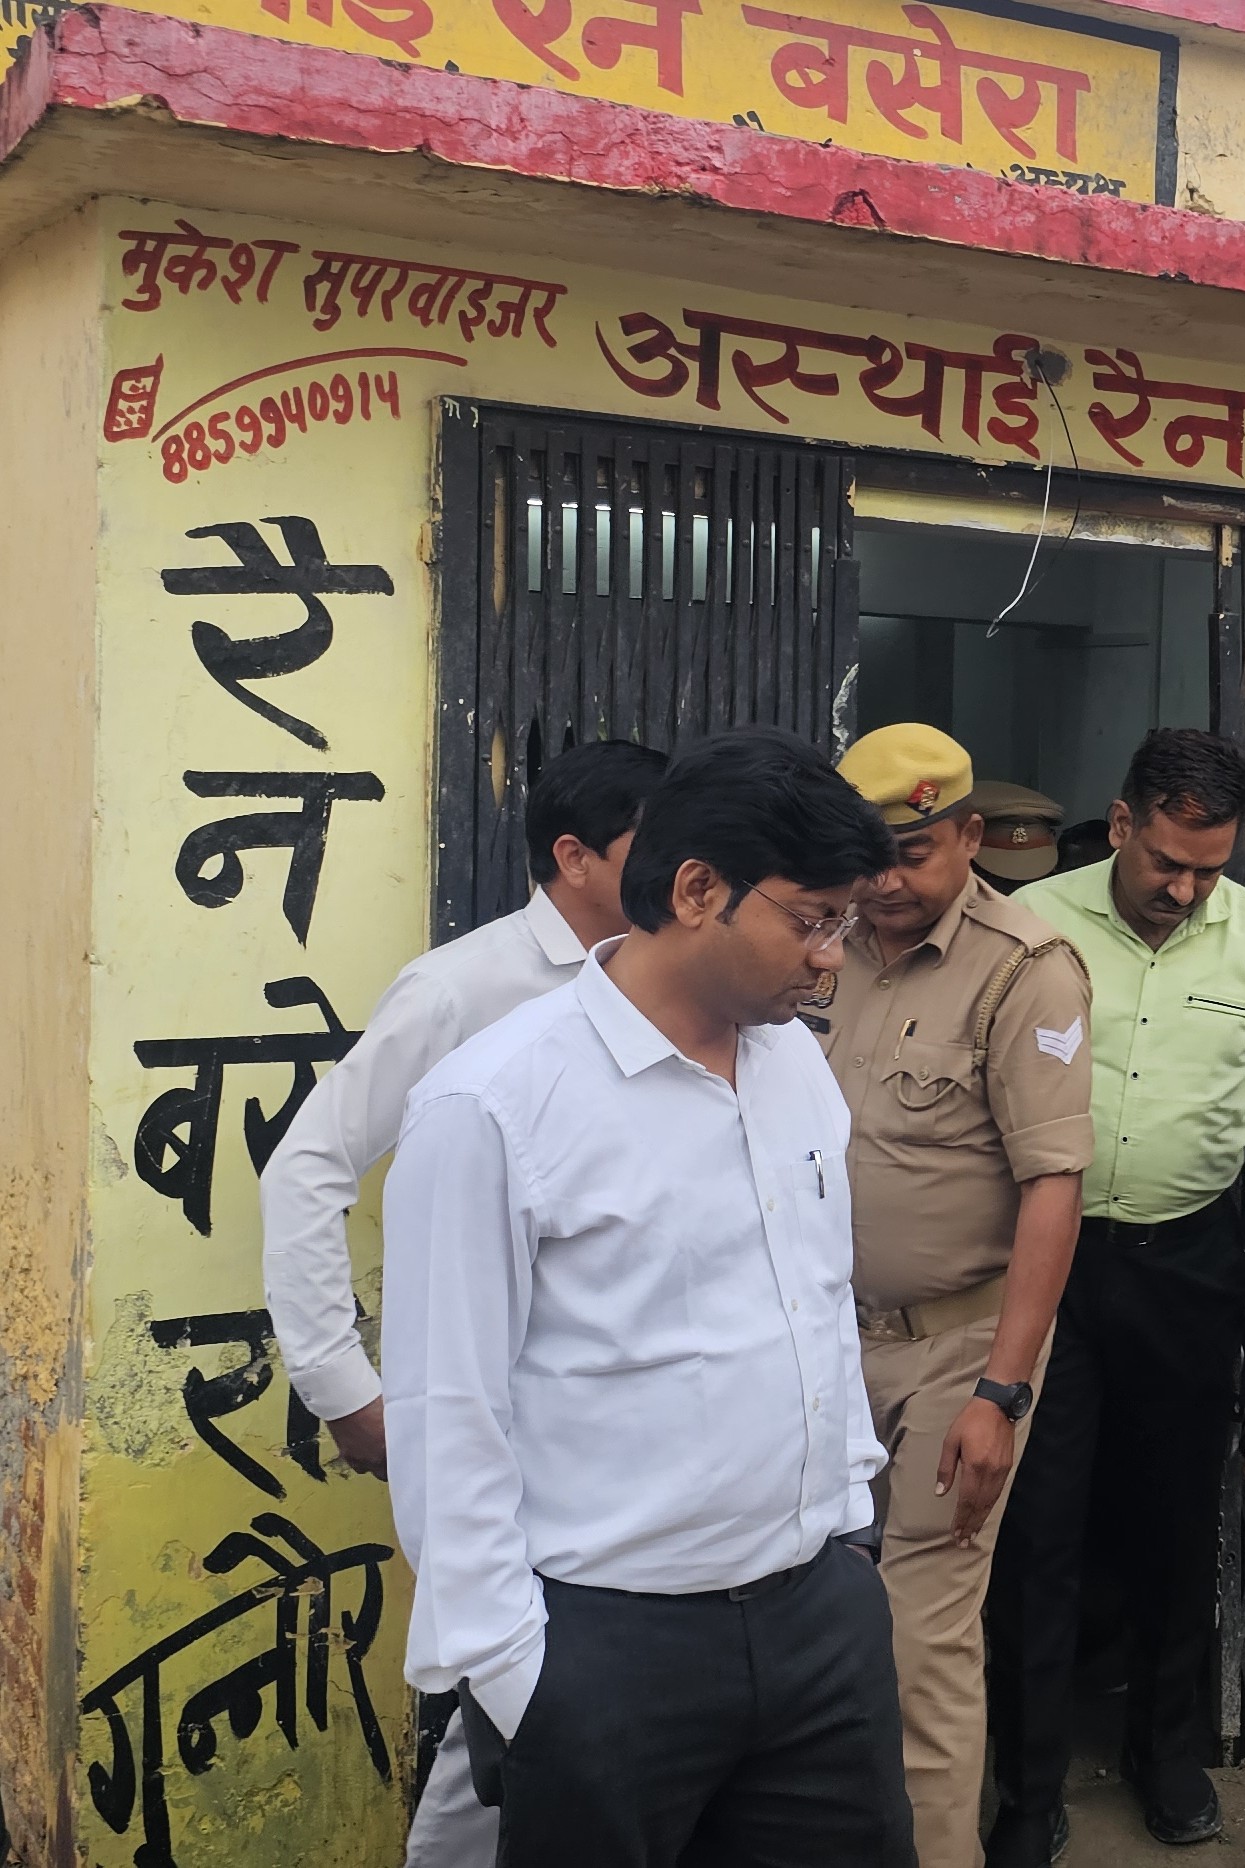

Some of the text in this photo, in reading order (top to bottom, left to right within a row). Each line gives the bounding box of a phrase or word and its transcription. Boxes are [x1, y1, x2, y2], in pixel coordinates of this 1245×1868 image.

[742, 3, 1090, 164] बसेरा
[118, 219, 567, 348] मुकेश सुपरवाइजर
[161, 371, 401, 484] 8859940914
[595, 308, 1041, 461] अस्थाई
